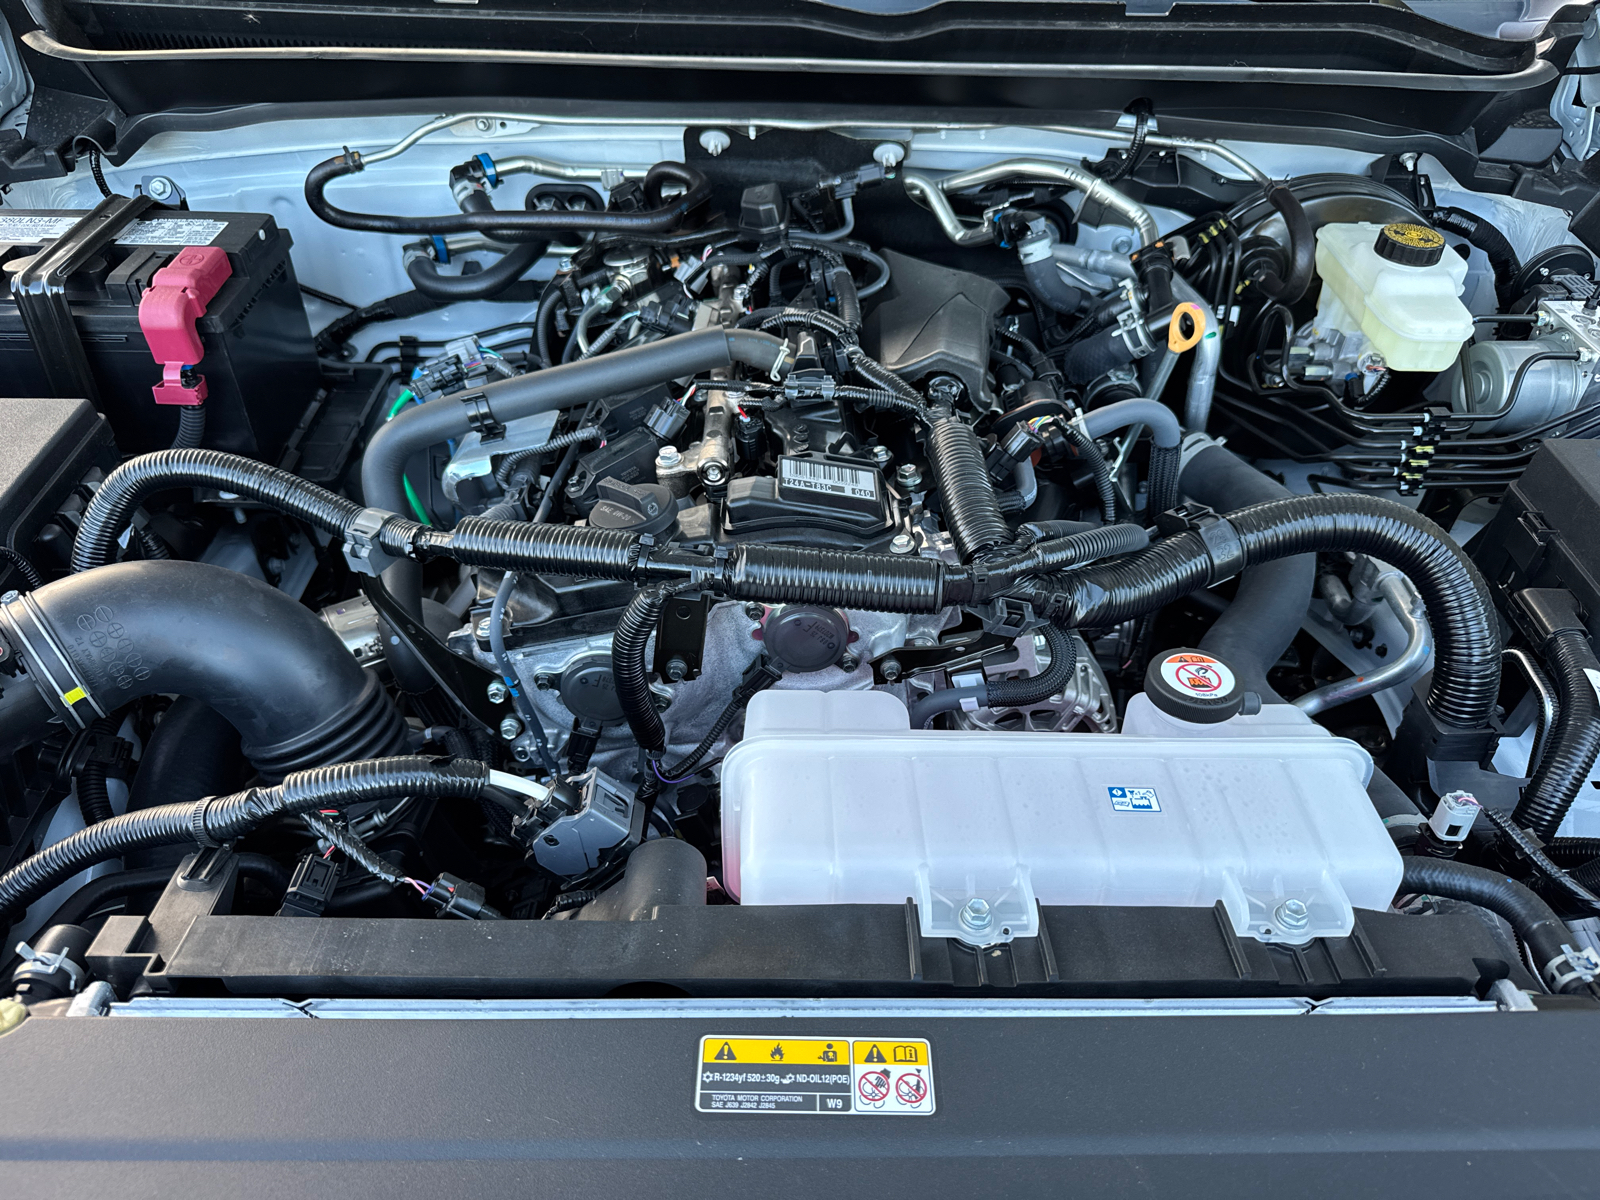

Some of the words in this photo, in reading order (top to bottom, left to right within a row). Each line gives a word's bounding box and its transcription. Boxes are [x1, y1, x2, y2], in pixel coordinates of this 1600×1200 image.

[855, 488, 871, 497] 040
[600, 505, 614, 514] SAE
[714, 1072, 746, 1084] R-1234yf
[746, 1073, 780, 1085] 520±30g
[796, 1073, 850, 1085] ND-OIL12(POE)
[760, 1095, 803, 1103] CORPORATION
[826, 1098, 843, 1109] W9
[725, 1101, 739, 1109] J639
[758, 1102, 776, 1110] J2845
